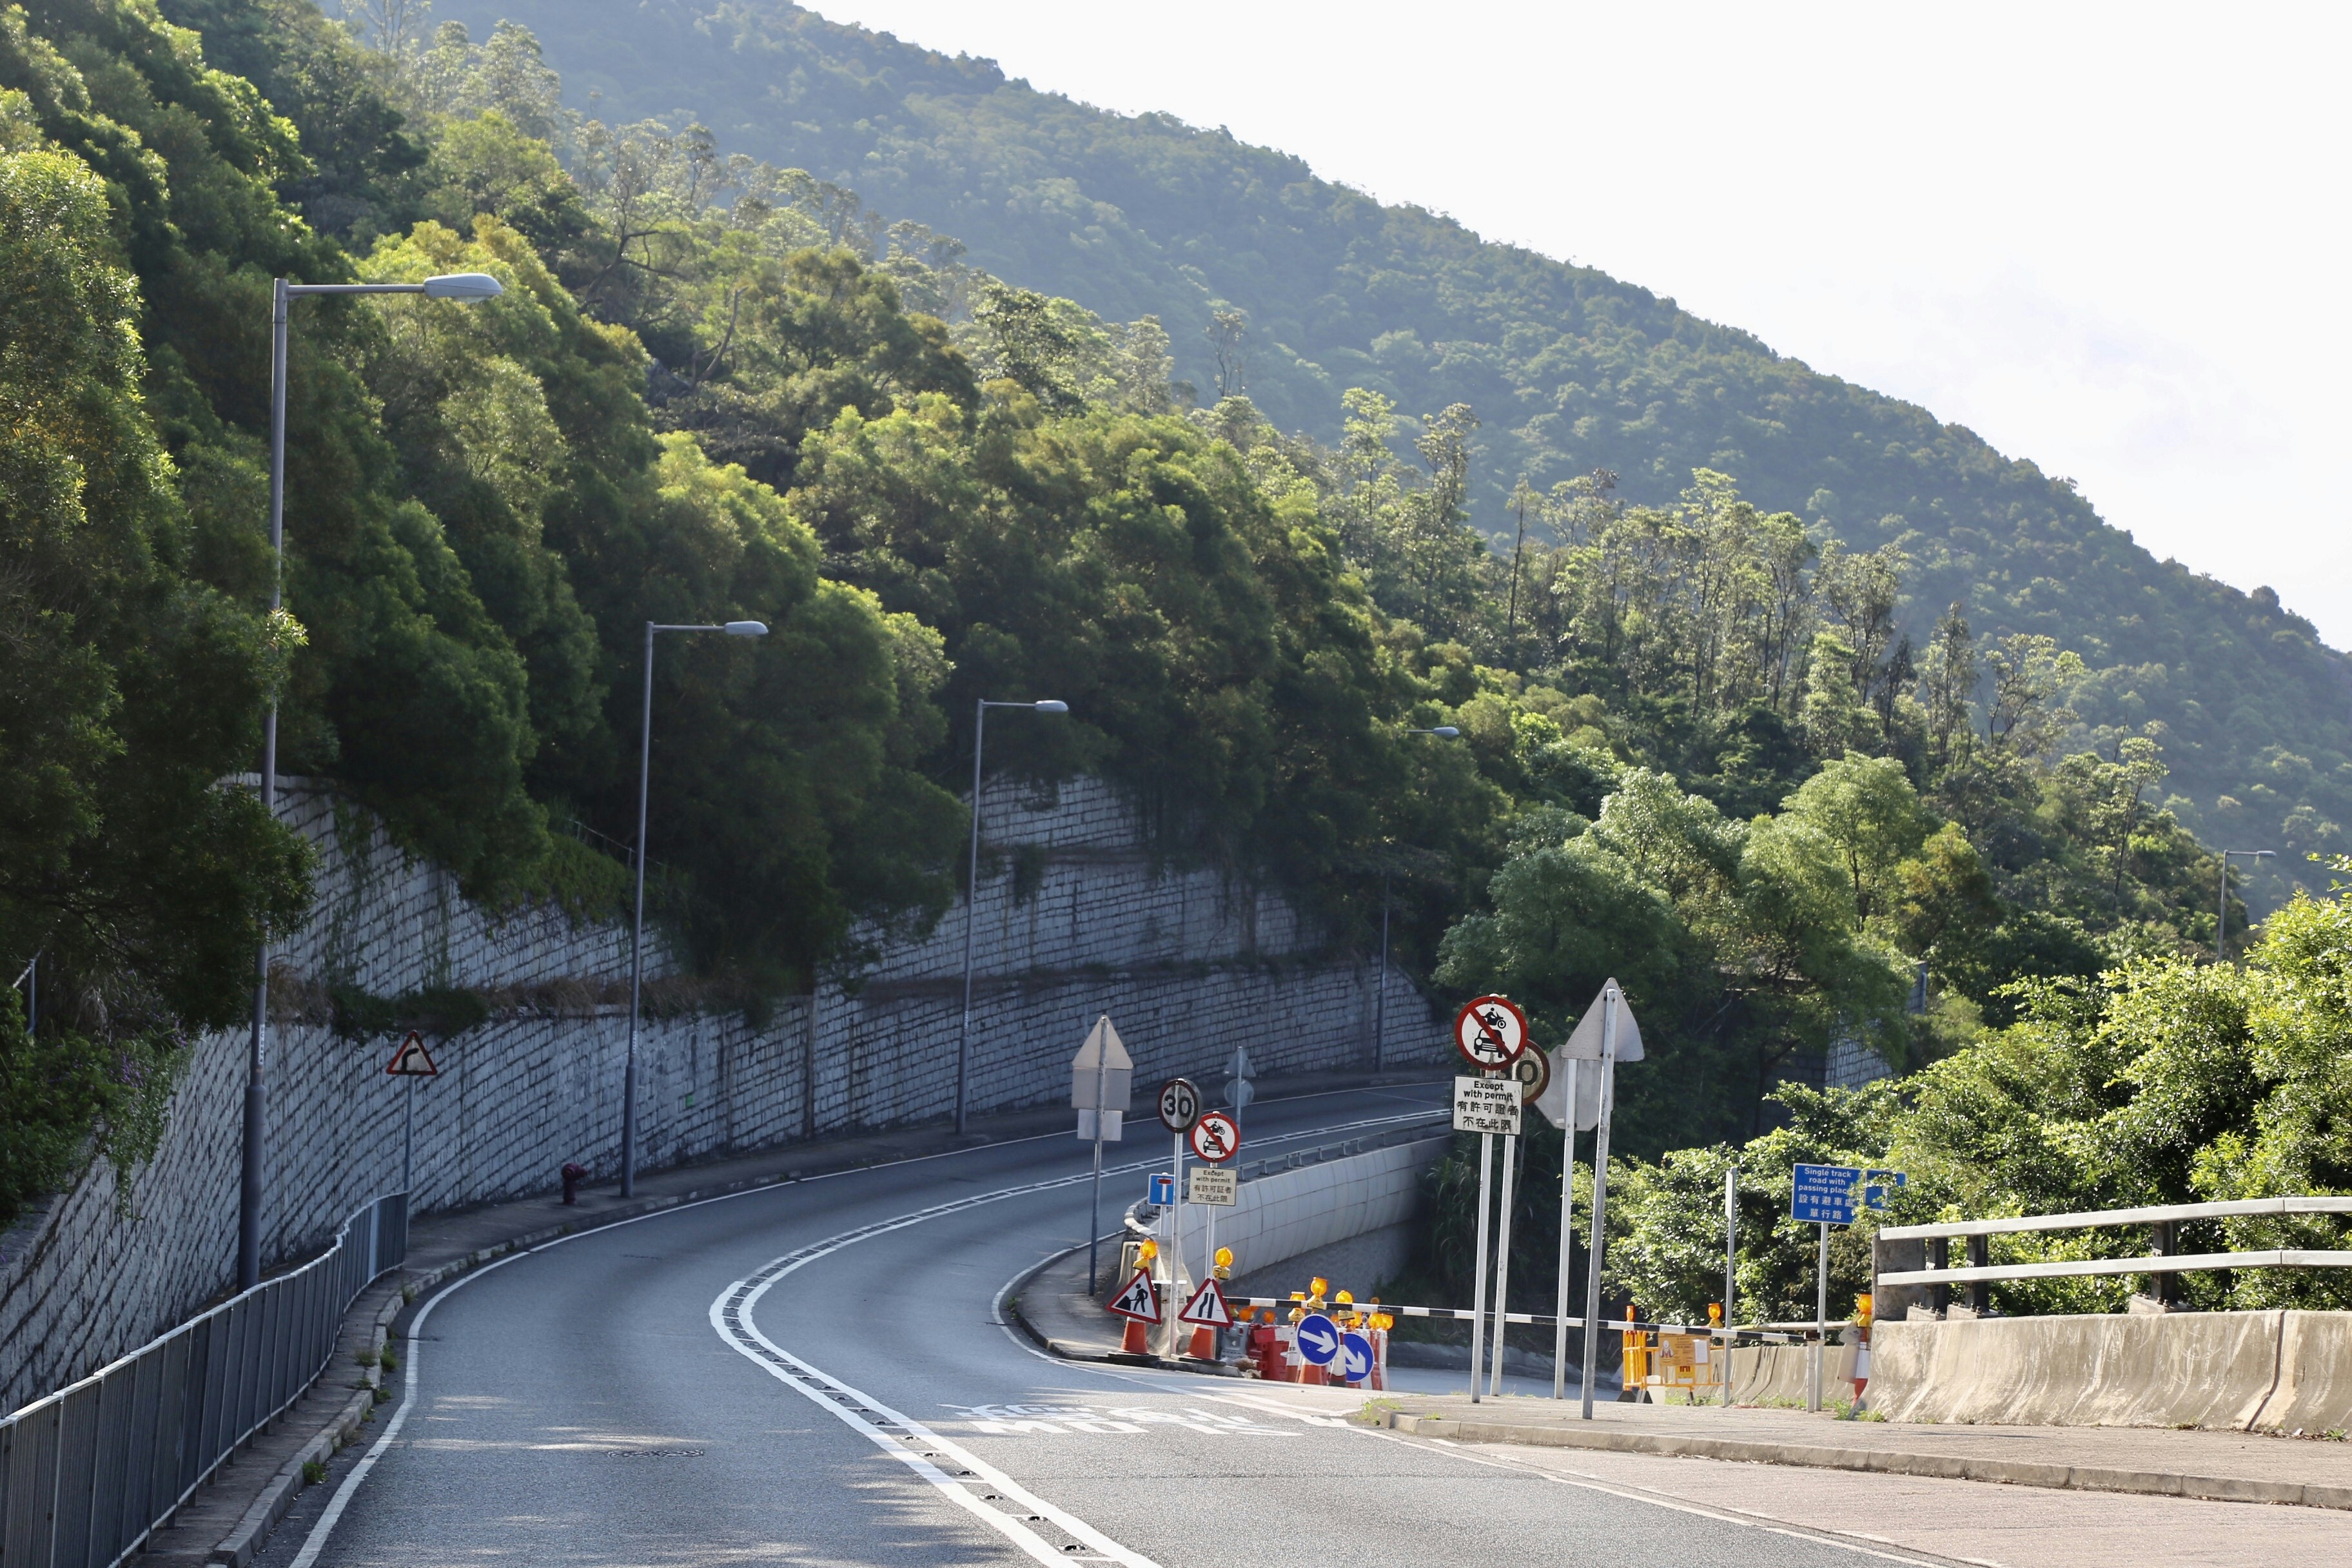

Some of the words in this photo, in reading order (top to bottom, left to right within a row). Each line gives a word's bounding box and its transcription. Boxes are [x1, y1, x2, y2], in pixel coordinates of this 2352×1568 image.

[1474, 1081, 1504, 1091] Except
[1464, 1090, 1482, 1098] with
[1485, 1092, 1513, 1101] permit
[1164, 1094, 1191, 1118] 30
[1457, 1101, 1518, 1115] 有許可證者
[1463, 1116, 1511, 1130] 不在此限
[1805, 1168, 1830, 1177] Single
[1831, 1170, 1852, 1178] track
[1798, 1185, 1828, 1194] passing
[1830, 1186, 1848, 1195] plac
[1197, 1193, 1228, 1203] 不在此限
[1809, 1208, 1842, 1220] 單行路
[968, 1420, 1305, 1436] SLOW
